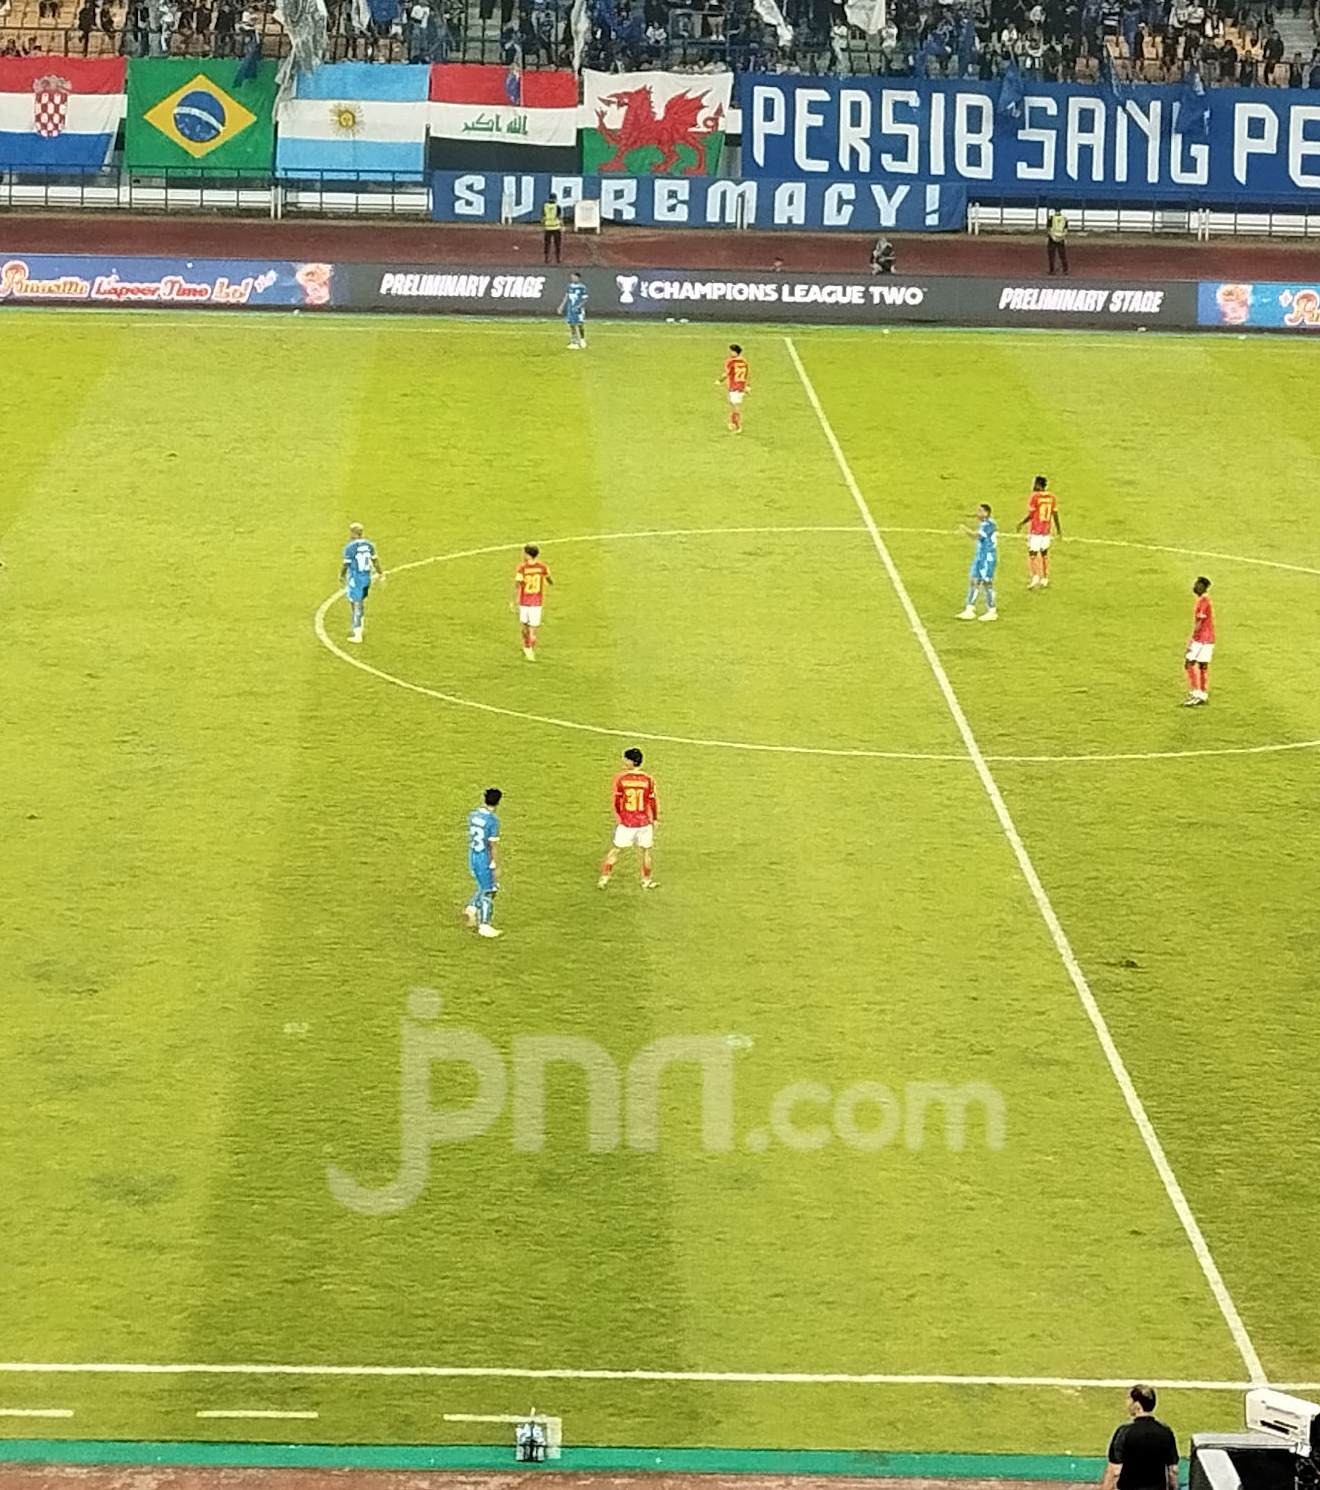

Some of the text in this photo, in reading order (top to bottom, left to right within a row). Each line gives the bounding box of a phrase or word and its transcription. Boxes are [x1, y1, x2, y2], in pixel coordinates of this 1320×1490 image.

[752, 85, 993, 180] PERSIB
[1016, 96, 1210, 185] SANG
[454, 173, 941, 228] SUPREMACY!
[380, 272, 546, 298] PRELIMINARY STAGE
[649, 279, 779, 302] CHAMPIONS
[781, 283, 865, 305] LEAGUE
[868, 286, 924, 306] TWO
[998, 286, 1165, 313] PRELIMINARY STAGE
[624, 788, 645, 812] 31
